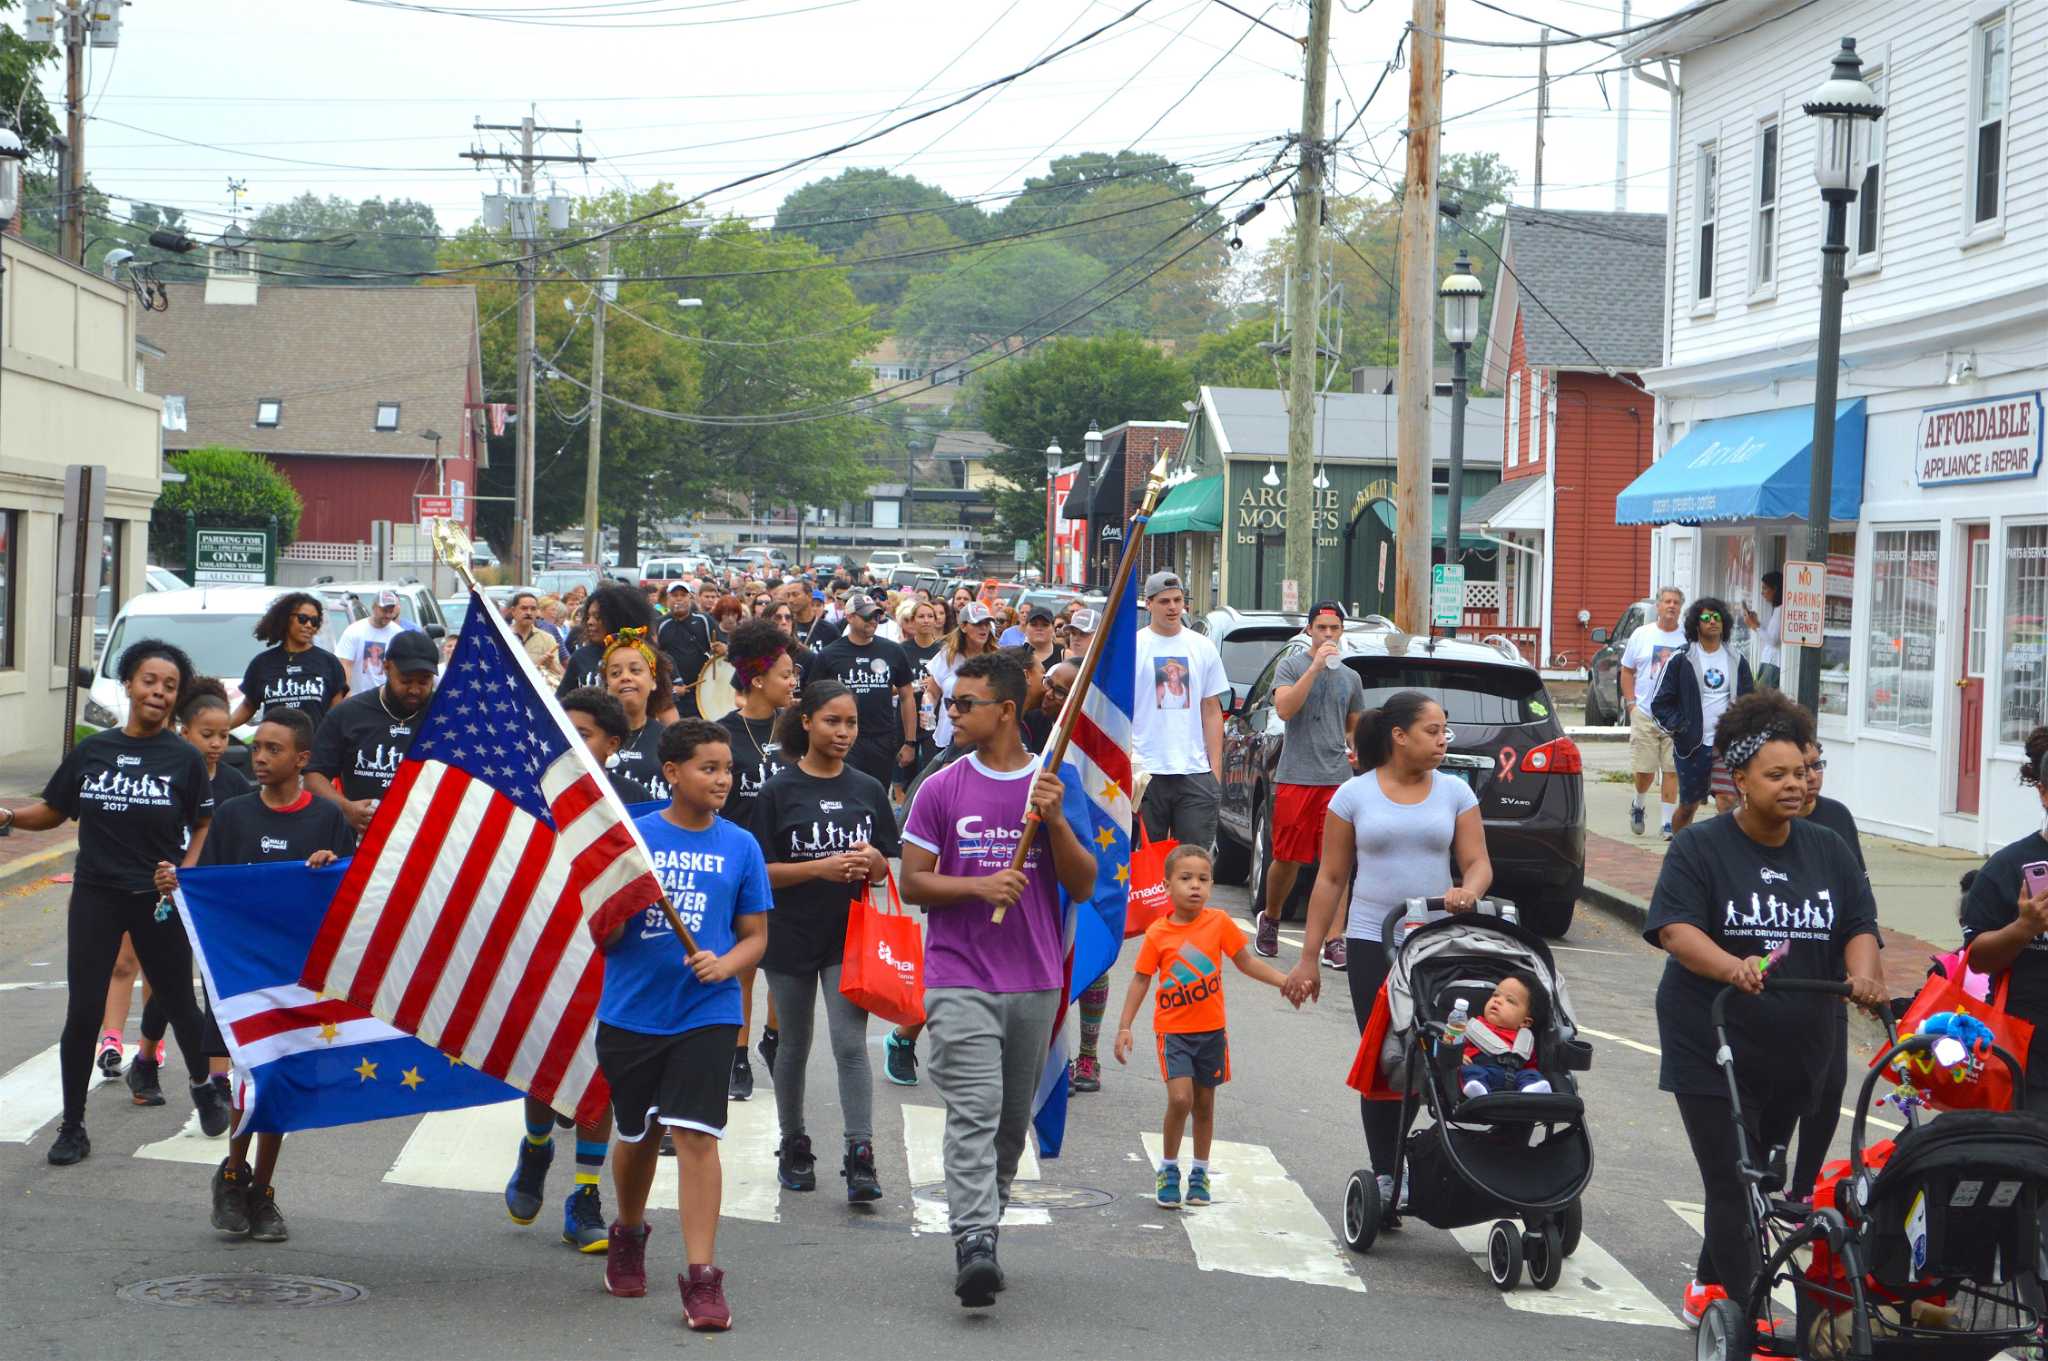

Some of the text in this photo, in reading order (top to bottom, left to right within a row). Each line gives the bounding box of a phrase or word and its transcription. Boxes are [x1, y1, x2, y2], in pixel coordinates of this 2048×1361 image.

[1924, 402, 2031, 448] AFFORDABLE
[1923, 448, 2029, 479] APPLIANCE & REPAIR
[202, 535, 261, 545] PARKING FOR
[212, 552, 250, 562] ONLY
[1798, 571, 1811, 585] NO
[1787, 591, 1821, 608] PARKING
[1787, 611, 1808, 621] HERE
[1811, 612, 1819, 622] TO
[1788, 623, 1817, 634] CORNER
[95, 794, 127, 802] DRIVING
[129, 797, 150, 805] ENDS
[103, 802, 128, 811] 2017
[956, 816, 1022, 839] Cabo
[655, 850, 725, 873] BASKET
[1755, 929, 1788, 938] DRIVING
[1160, 976, 1221, 1009] adida
